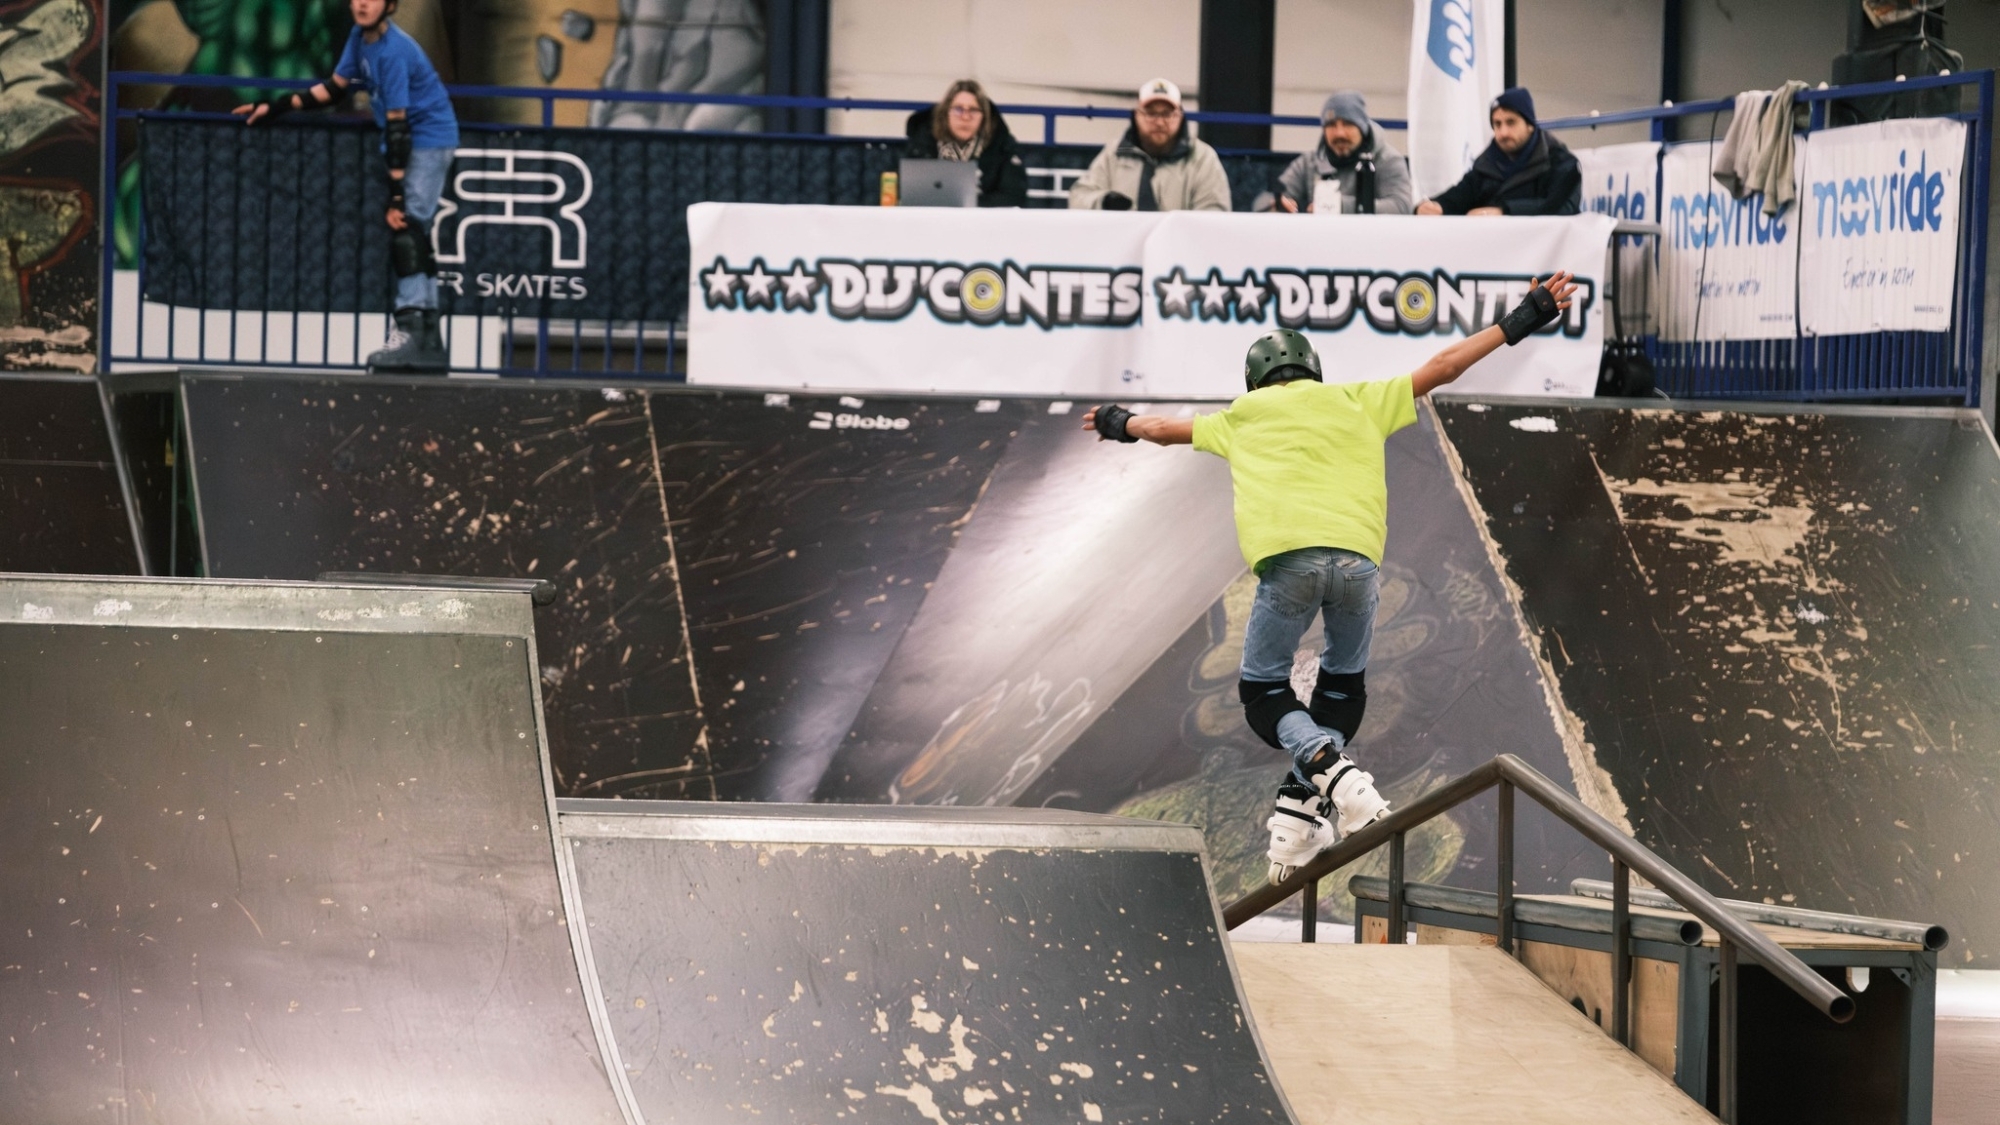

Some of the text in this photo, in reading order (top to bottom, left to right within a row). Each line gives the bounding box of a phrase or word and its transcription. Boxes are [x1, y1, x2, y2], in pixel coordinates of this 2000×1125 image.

[1813, 149, 1945, 239] moovride
[476, 272, 588, 300] SKATES
[835, 412, 911, 430] globe
